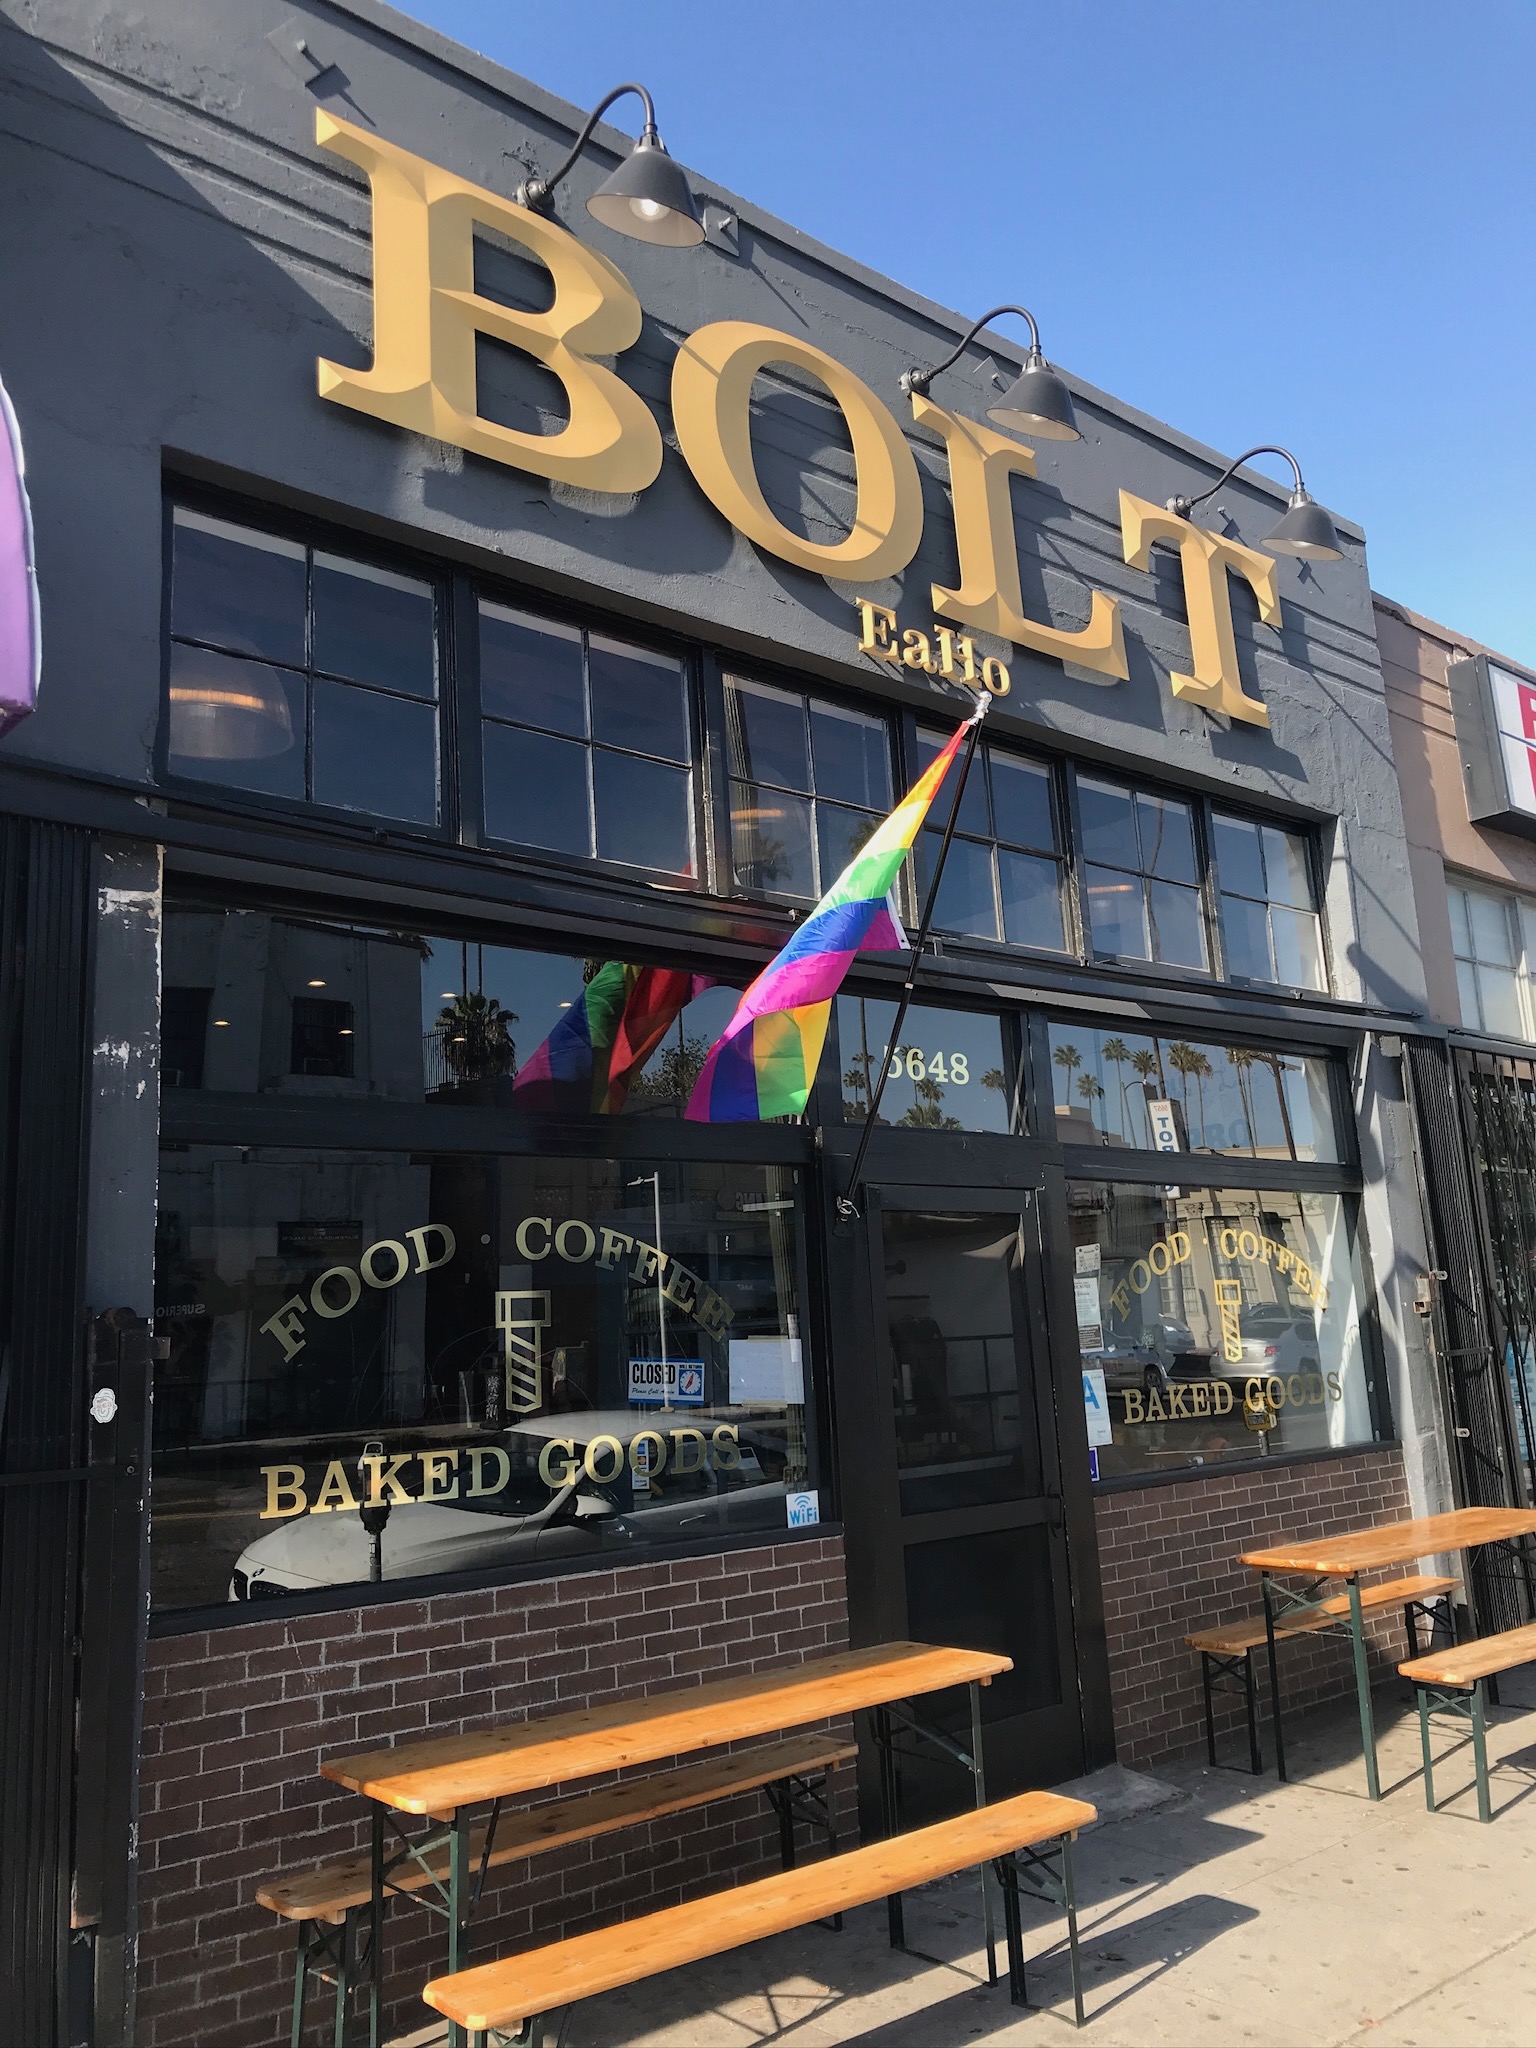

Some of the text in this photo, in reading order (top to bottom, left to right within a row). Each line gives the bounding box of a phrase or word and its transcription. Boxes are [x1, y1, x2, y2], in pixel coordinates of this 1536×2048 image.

[315, 106, 1282, 729] BOLT
[855, 597, 1011, 697] EaHo
[884, 1045, 970, 1085] 5648
[259, 1217, 735, 1363] FOOD COFFEE
[1111, 1228, 1331, 1322] FOOD COFFEE
[633, 1364, 675, 1384] CLOSED
[1123, 1371, 1342, 1424] BAKED GOODS
[260, 1424, 741, 1519] BAKED GOODS
[790, 1506, 817, 1525] WiFi
